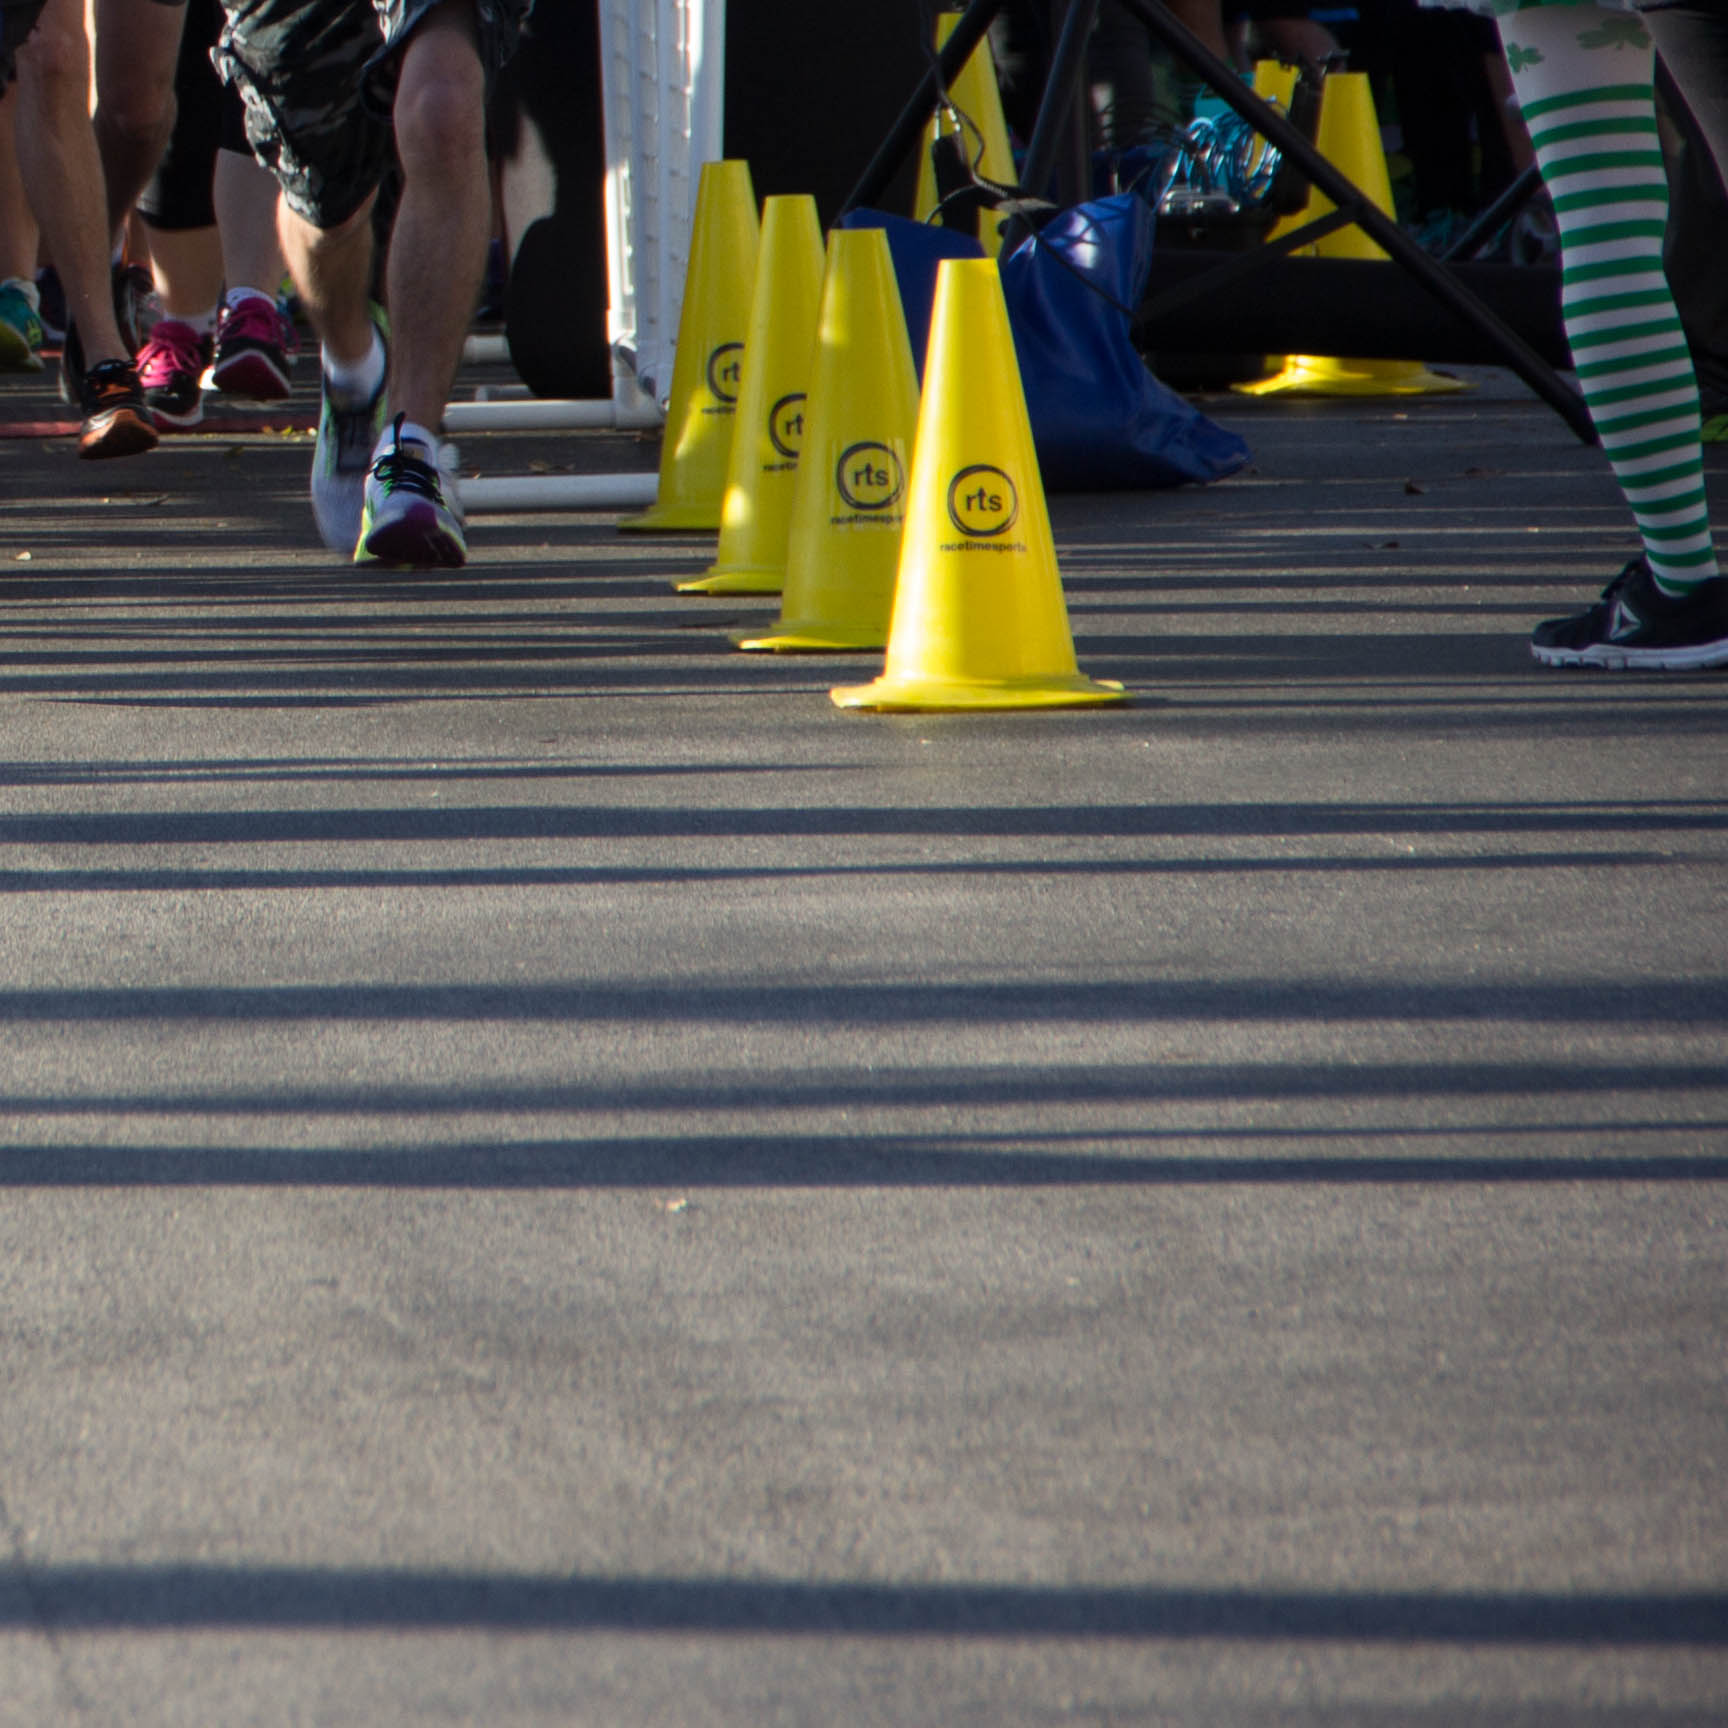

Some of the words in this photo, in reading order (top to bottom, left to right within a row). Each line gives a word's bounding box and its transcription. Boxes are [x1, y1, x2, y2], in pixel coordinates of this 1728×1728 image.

[855, 462, 889, 486] rts
[965, 485, 1003, 512] rts
[939, 539, 1028, 554] racetimesports
